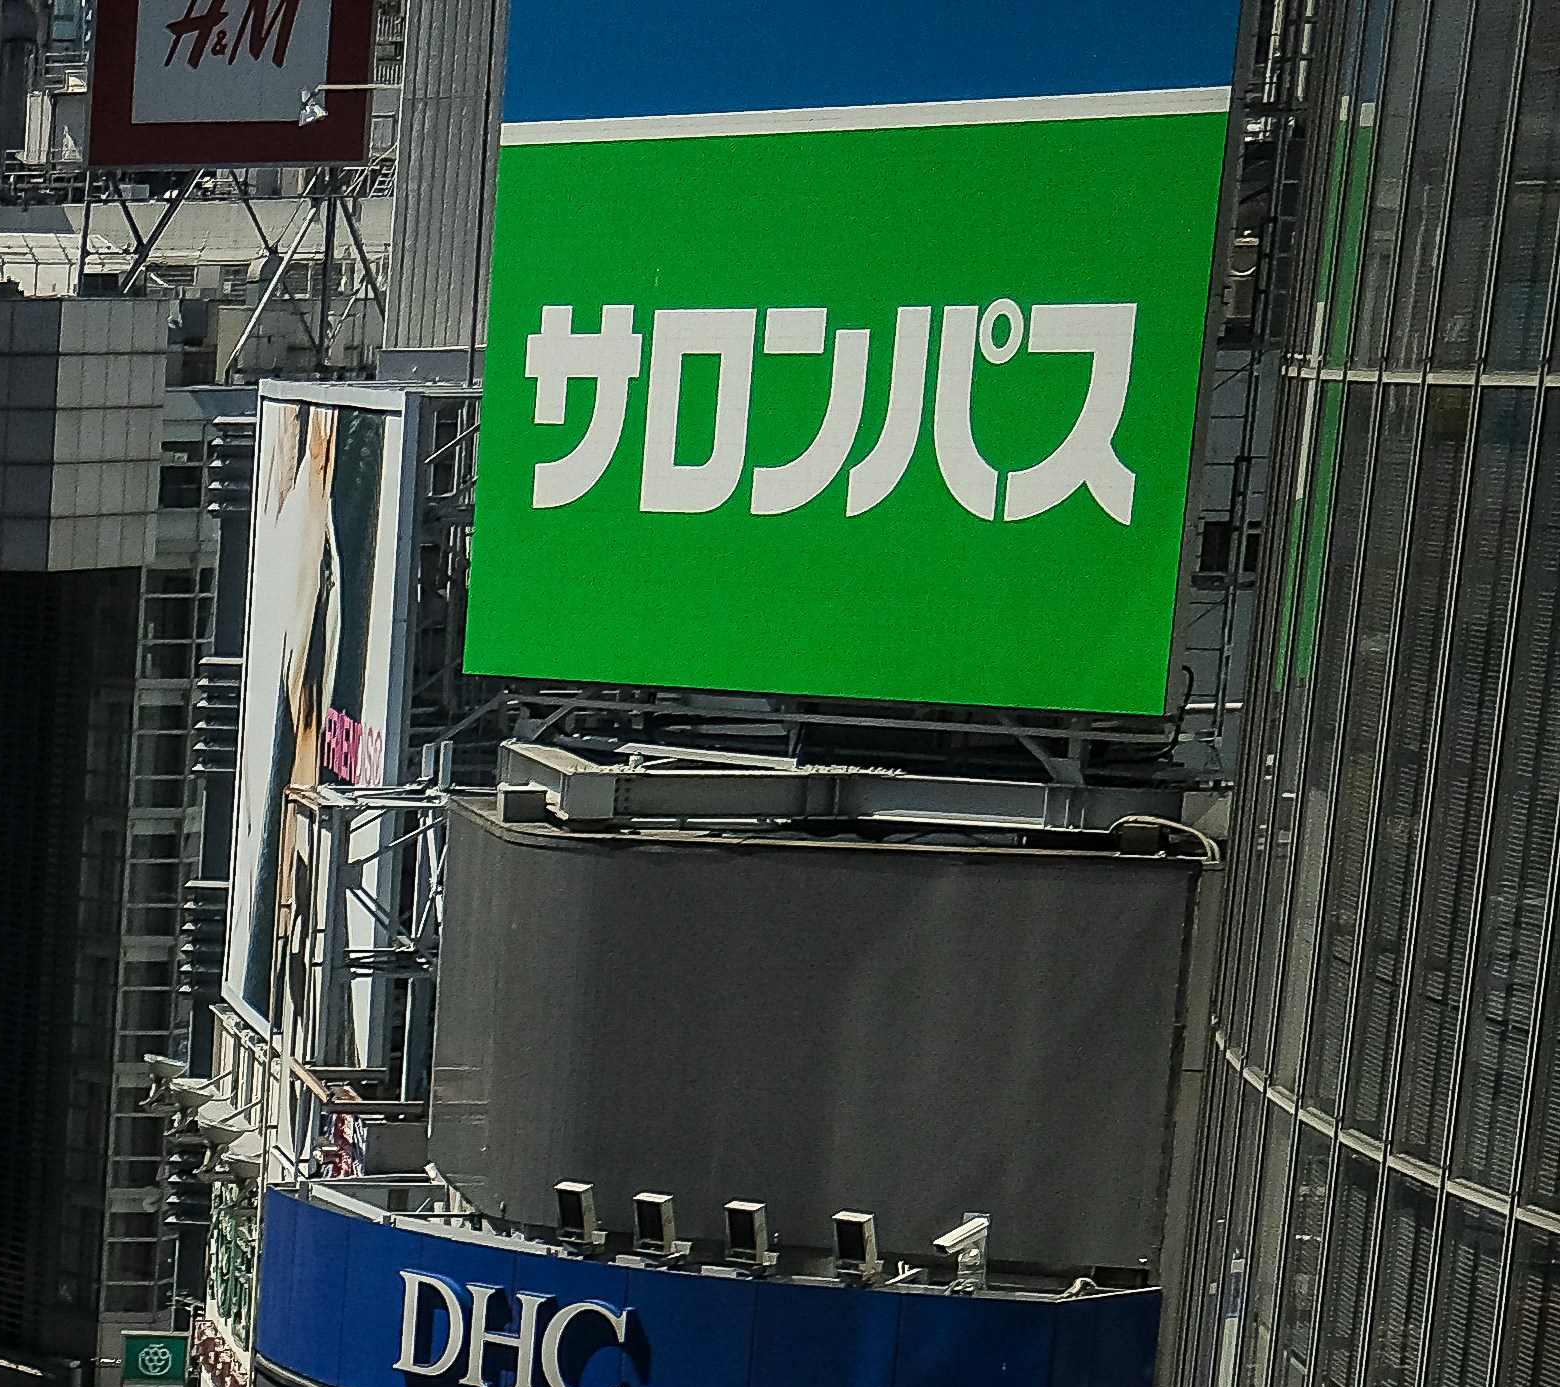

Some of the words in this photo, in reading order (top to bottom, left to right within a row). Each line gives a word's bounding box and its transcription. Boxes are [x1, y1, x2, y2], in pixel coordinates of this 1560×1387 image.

[524, 296, 1138, 527] サロンパス
